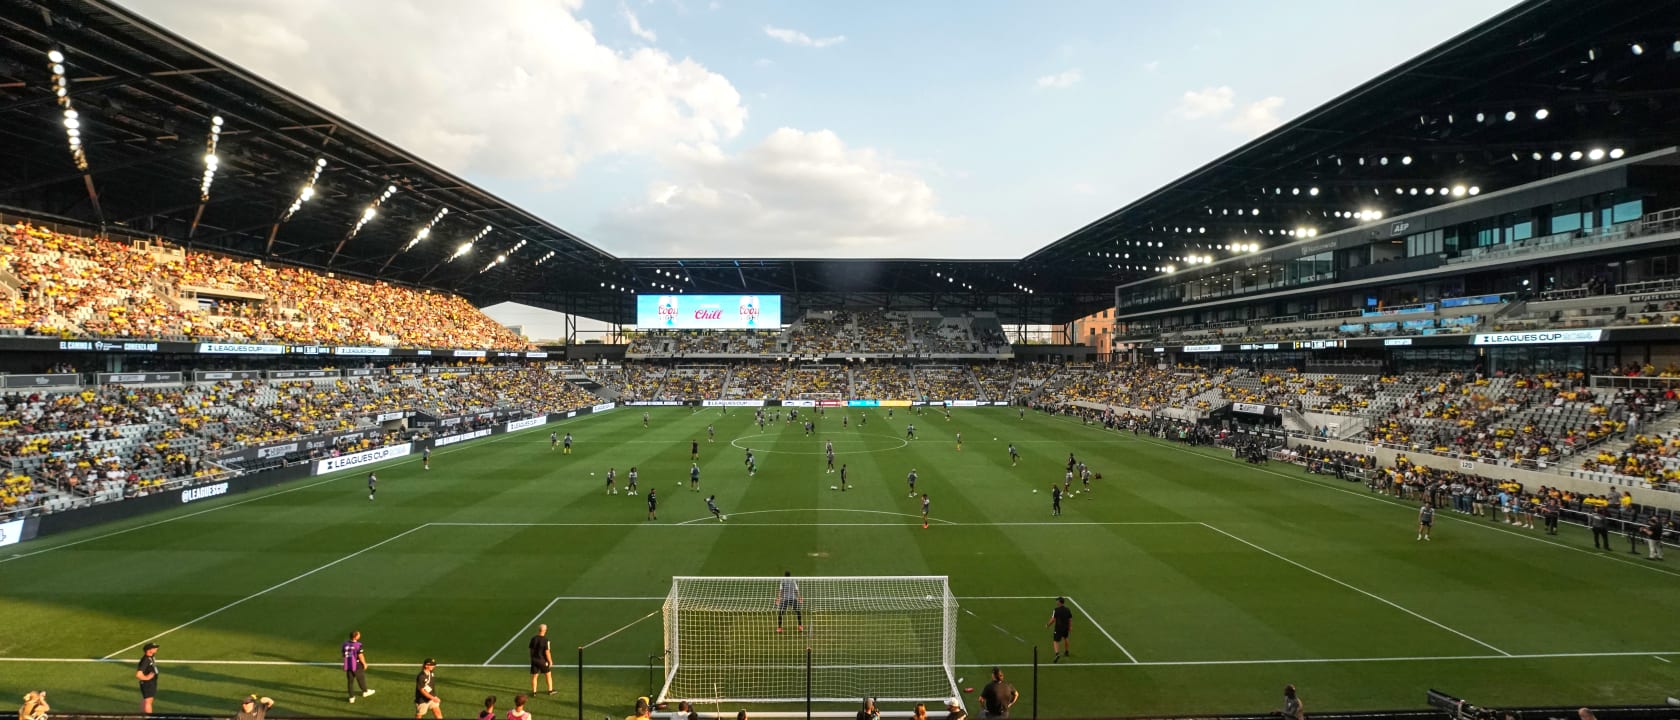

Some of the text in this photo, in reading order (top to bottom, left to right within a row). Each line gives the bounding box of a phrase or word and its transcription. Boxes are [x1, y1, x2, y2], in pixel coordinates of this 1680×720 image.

[1394, 223, 1409, 232] AEP
[694, 309, 722, 320] Chill
[1491, 334, 1538, 343] LEAGUES
[1538, 333, 1562, 342] CUP
[334, 453, 373, 468] LEAGUES
[373, 449, 389, 460] CUP
